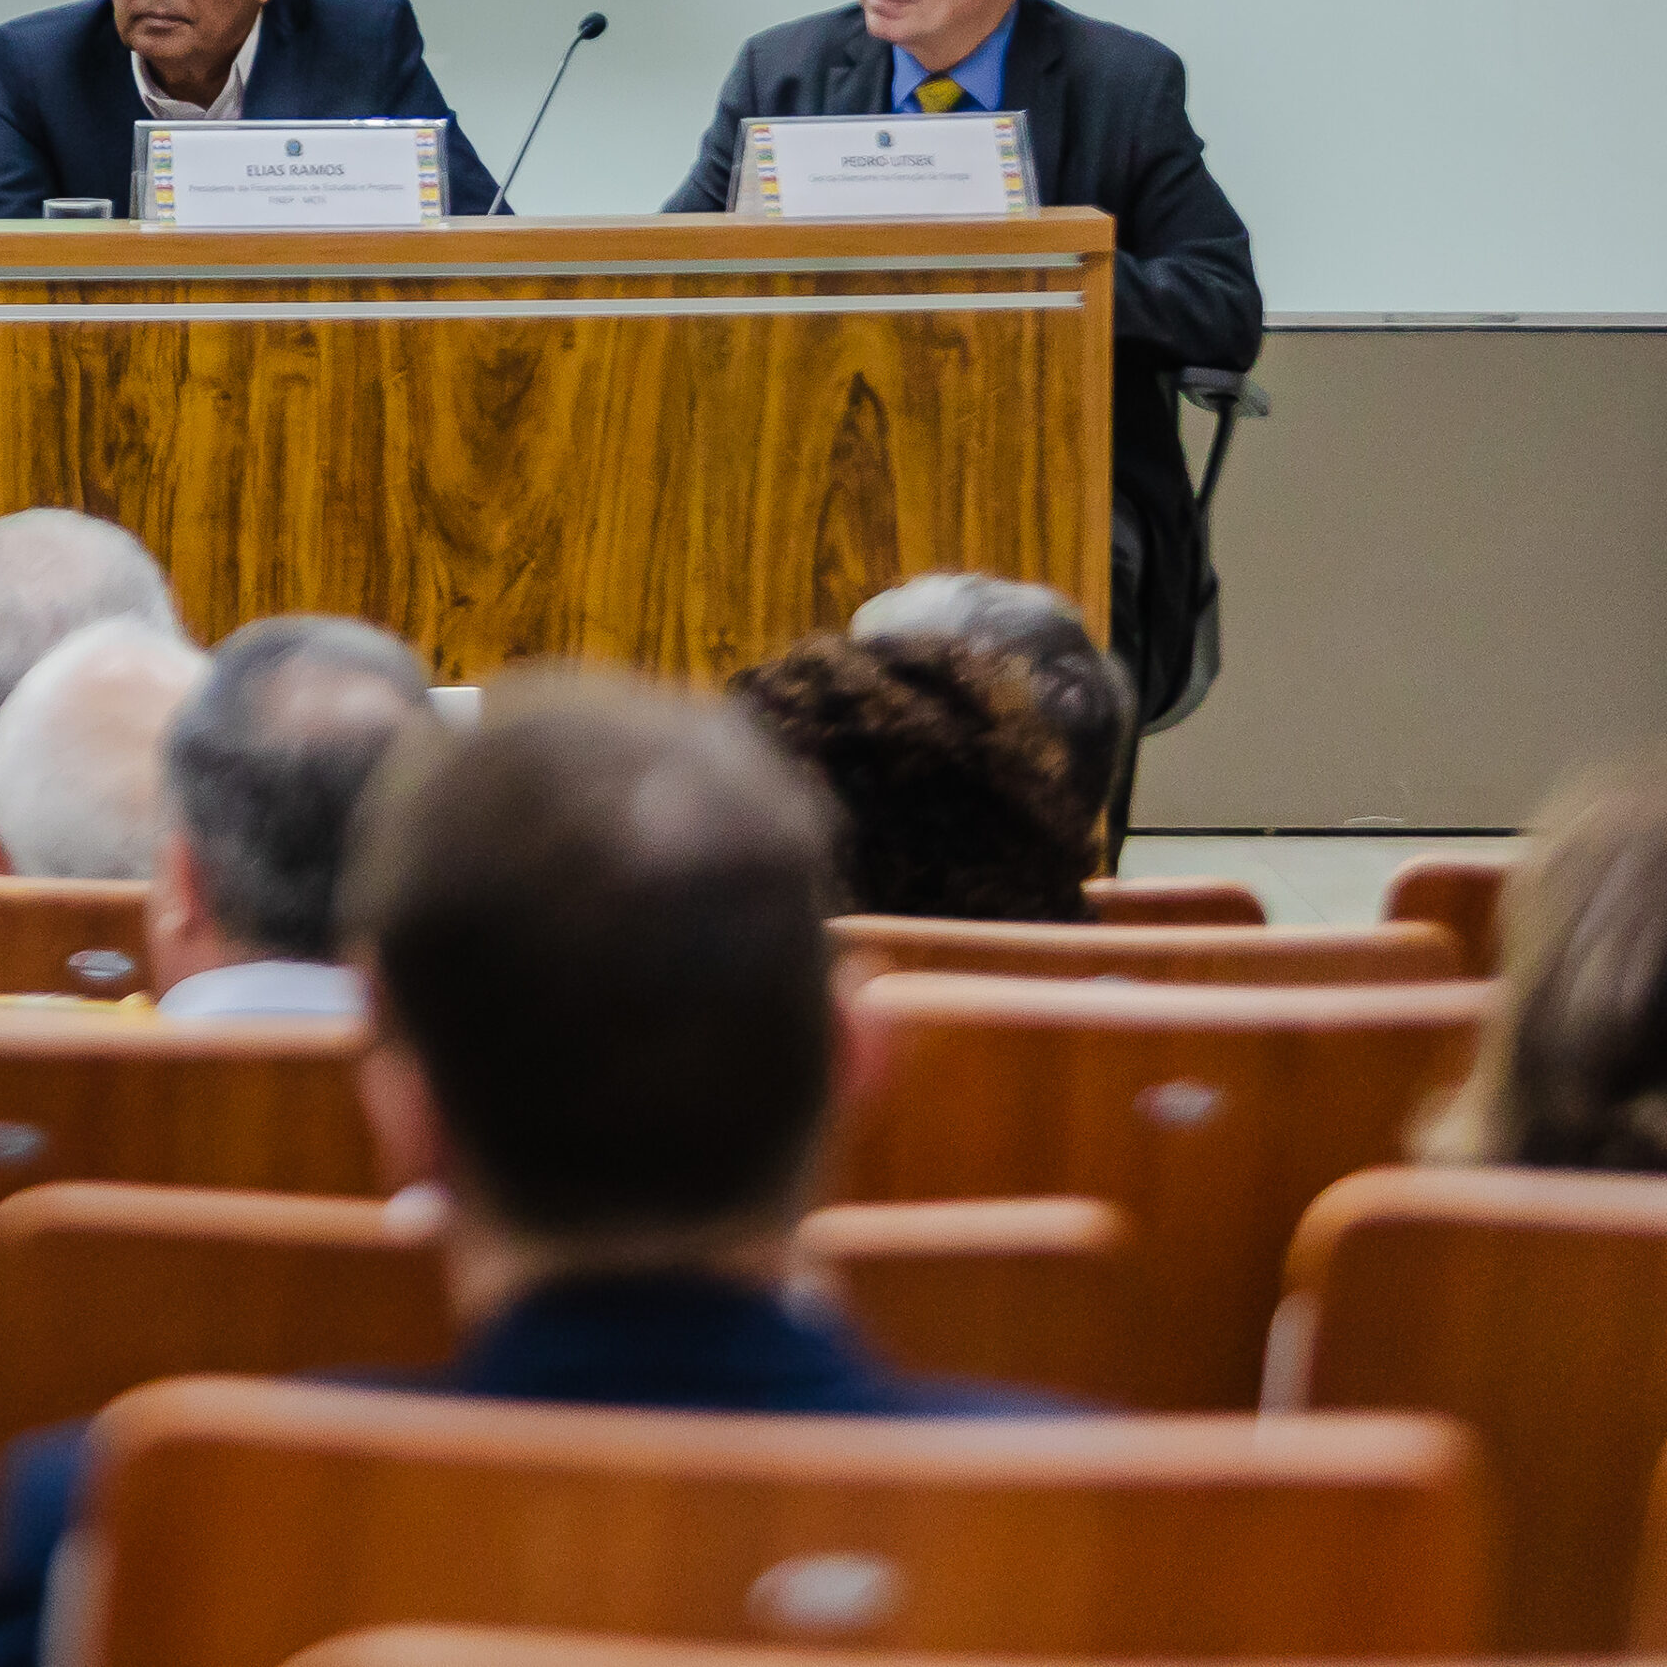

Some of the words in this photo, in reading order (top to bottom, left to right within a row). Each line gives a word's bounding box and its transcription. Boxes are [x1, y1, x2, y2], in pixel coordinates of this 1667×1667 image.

[840, 155, 889, 168] PEDRO
[246, 164, 285, 176] ELIAS
[289, 164, 345, 176] RAMOS
